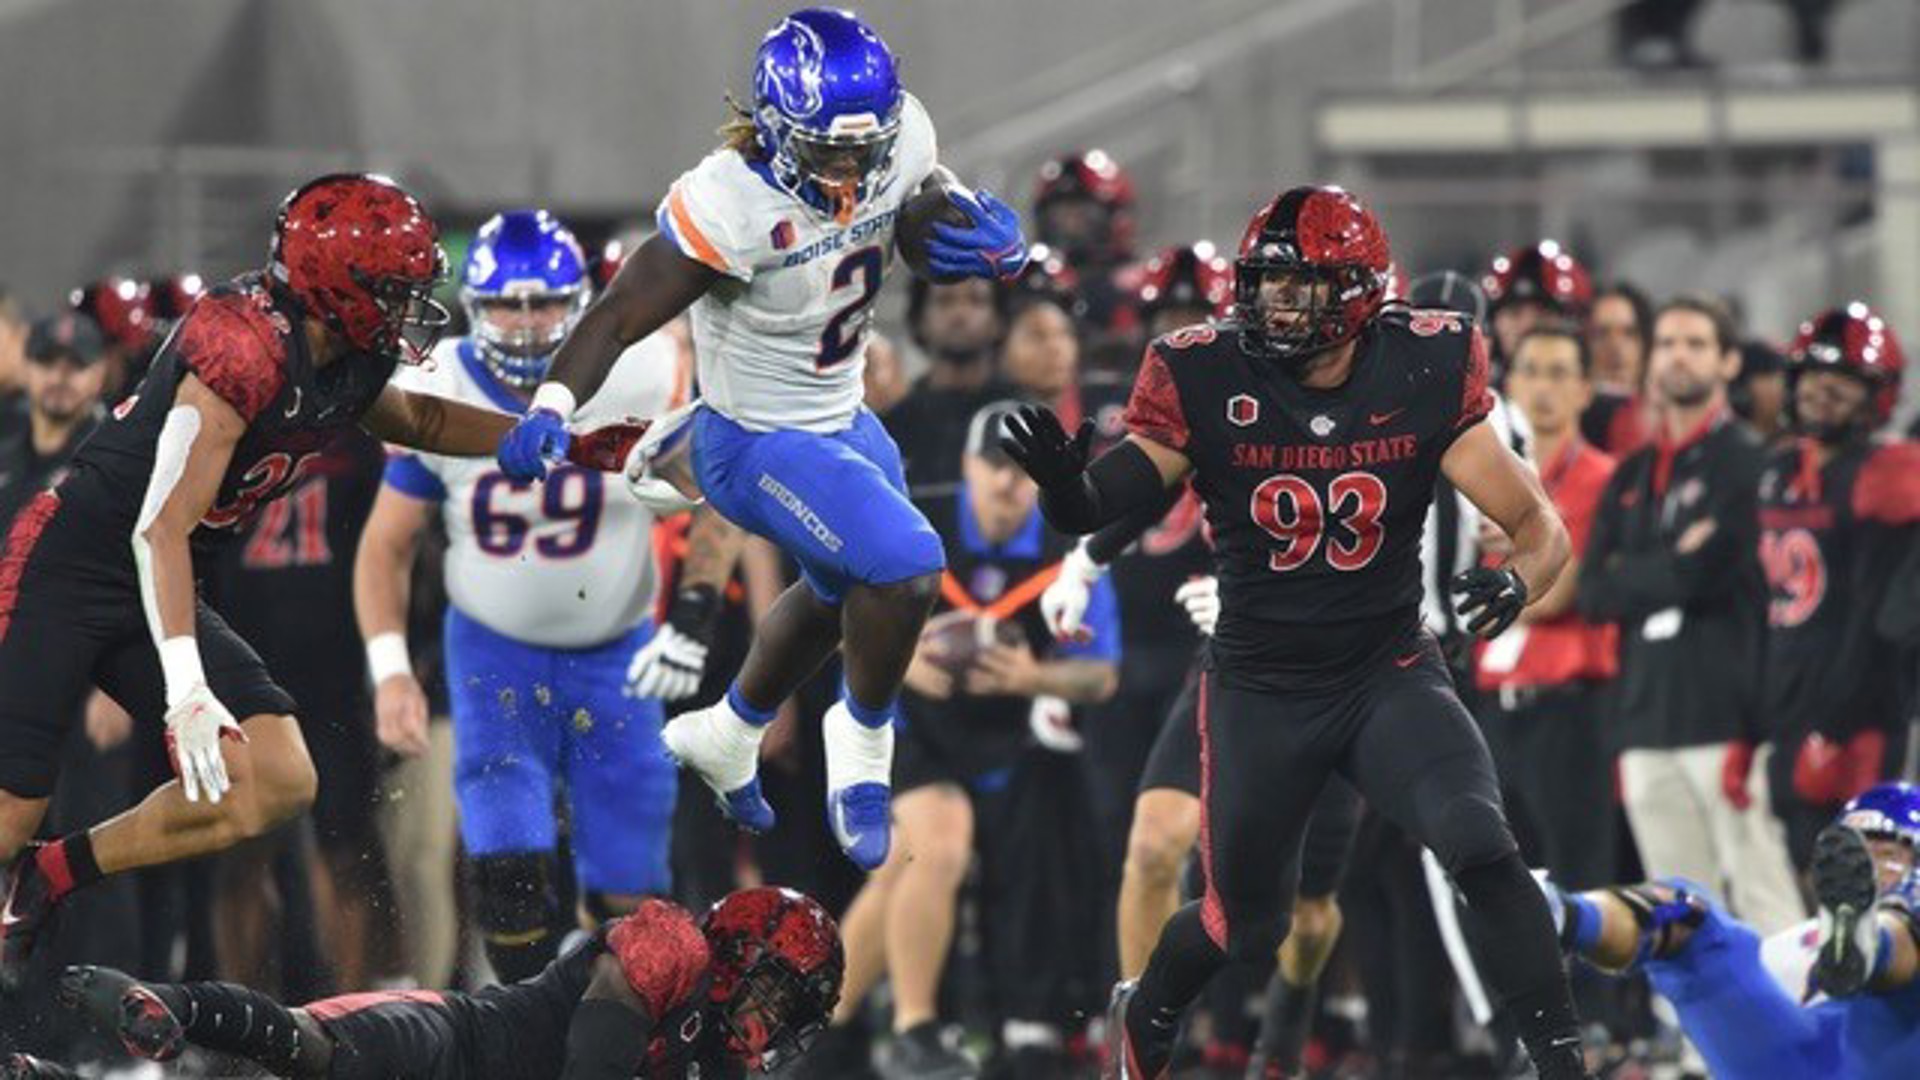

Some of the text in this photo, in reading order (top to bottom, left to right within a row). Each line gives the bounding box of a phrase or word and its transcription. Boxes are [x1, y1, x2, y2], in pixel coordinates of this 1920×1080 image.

[782, 209, 898, 268] BOISE STAT
[815, 244, 883, 370] 2
[1232, 434, 1417, 469] SAN DIEGO STATE
[470, 464, 605, 559] 69
[759, 474, 845, 553] BRONCOS
[1251, 472, 1388, 571] 93
